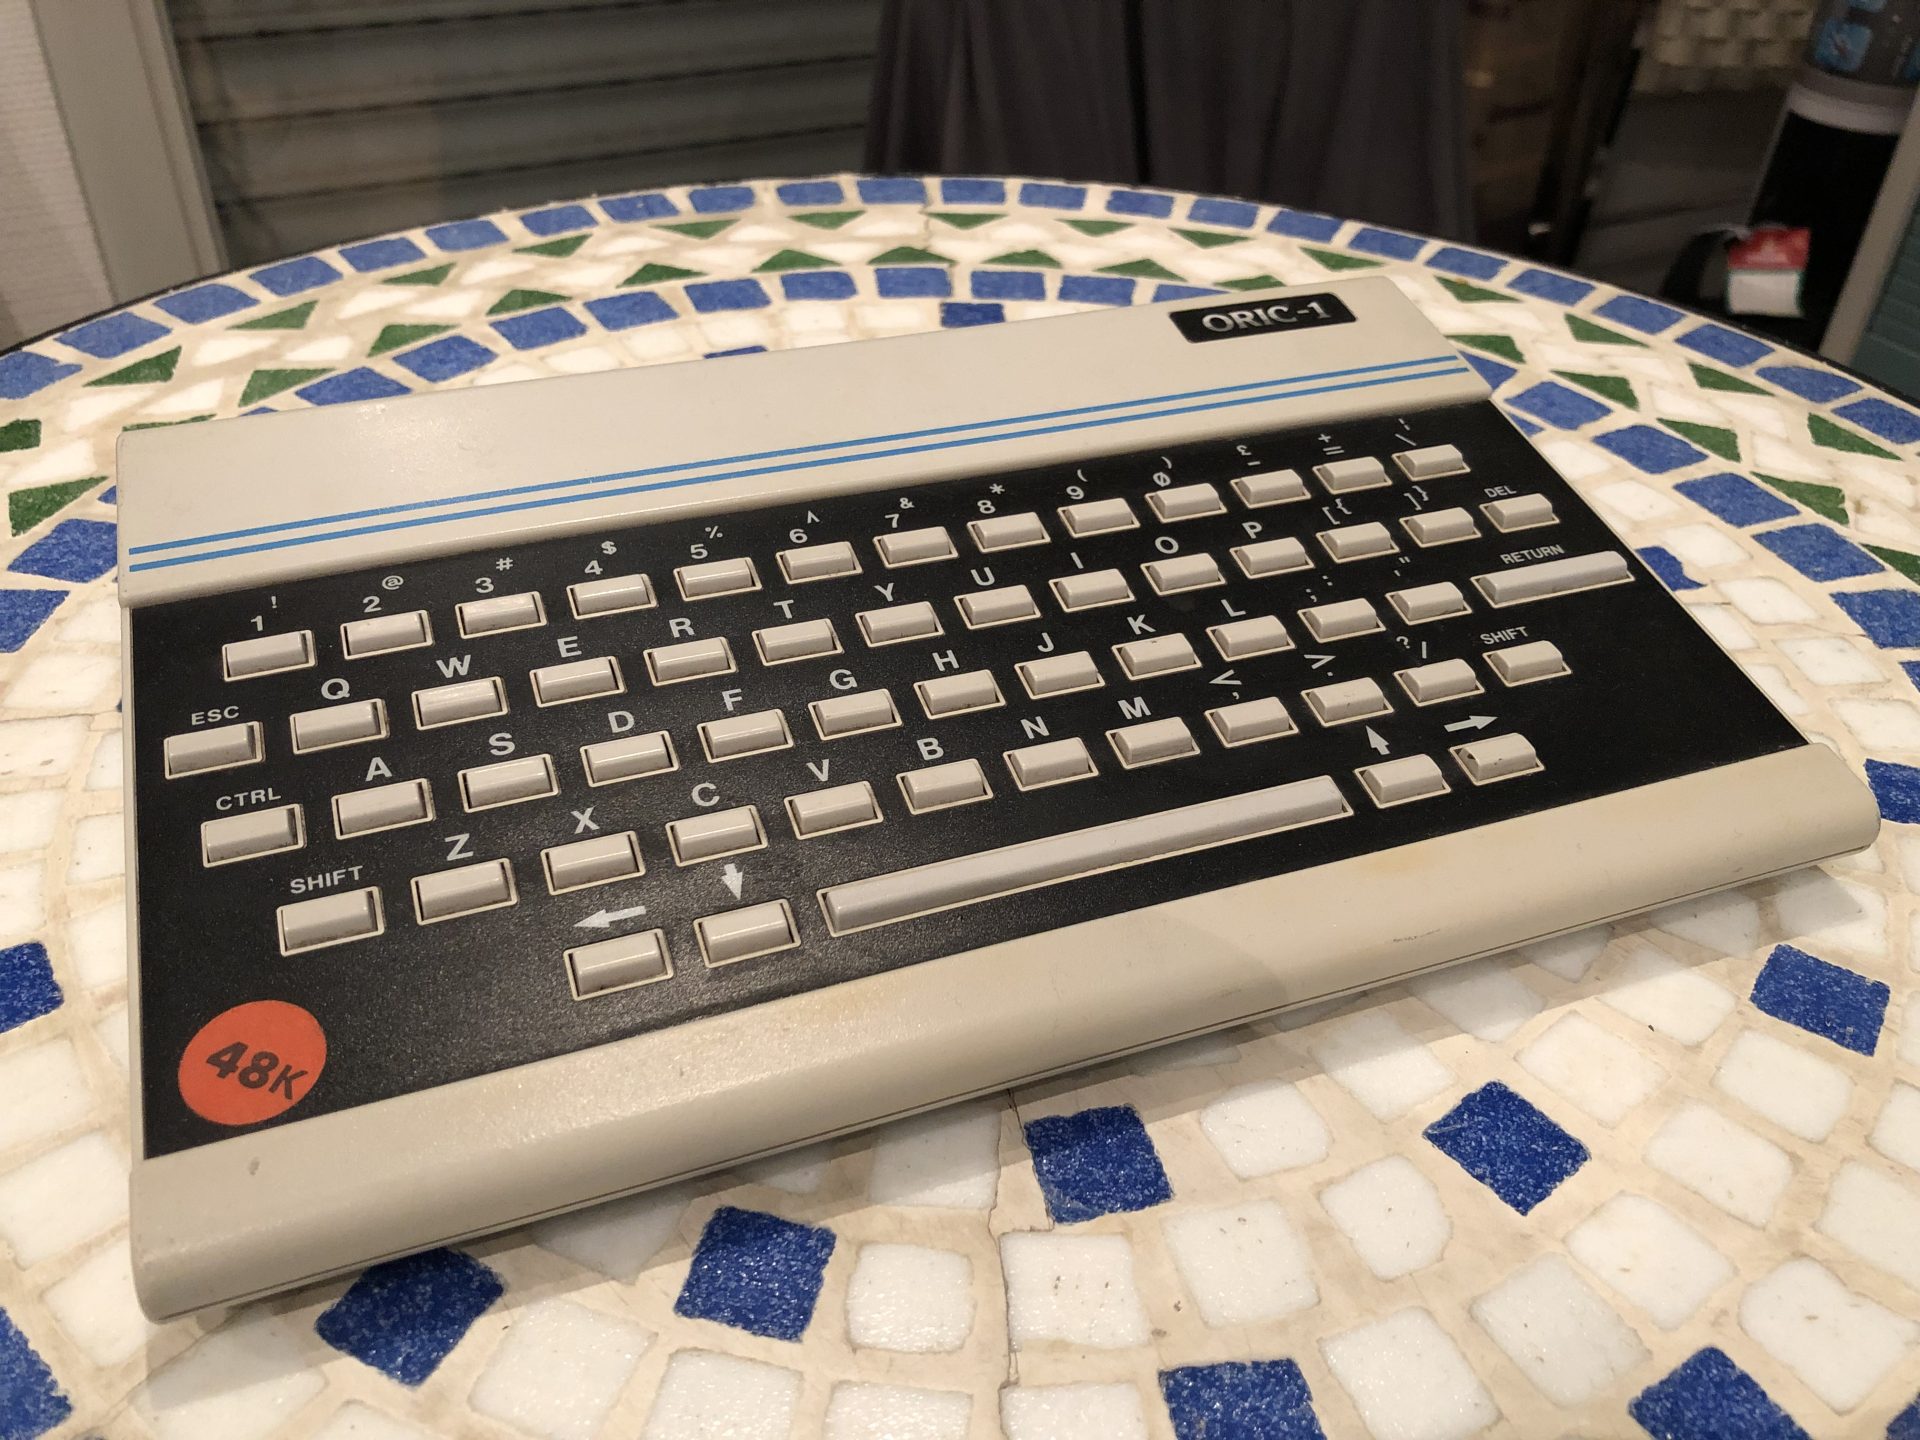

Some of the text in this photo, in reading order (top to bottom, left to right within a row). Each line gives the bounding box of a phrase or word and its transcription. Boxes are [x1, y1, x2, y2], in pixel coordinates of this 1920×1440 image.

[1201, 301, 1331, 332] ORIC-1
[1322, 445, 1345, 456] =
[1066, 485, 1085, 500] 9
[1484, 485, 1517, 499] DEL
[899, 497, 915, 509] &
[977, 499, 996, 514] 8
[884, 513, 900, 529] 7
[1241, 521, 1263, 539] P
[704, 525, 723, 539] %
[789, 528, 808, 544] 6
[601, 540, 617, 555] $
[690, 543, 708, 560] 5
[1154, 536, 1179, 555] O
[1500, 544, 1565, 566] RETURN
[495, 557, 514, 571] #
[585, 560, 603, 574] 4
[1070, 551, 1084, 570] I
[381, 575, 404, 591] @
[475, 577, 495, 594] 3
[970, 566, 995, 586] U
[873, 582, 895, 602] Y
[362, 595, 382, 613] 2
[773, 599, 794, 619] T
[1220, 599, 1247, 617] L
[250, 615, 264, 632] 1
[668, 617, 695, 638] R
[1126, 614, 1156, 635] K
[1037, 632, 1055, 653] J
[1396, 635, 1410, 649] ?
[1480, 626, 1530, 646] SHIFT
[556, 635, 582, 658] E
[435, 654, 472, 679] W
[932, 649, 960, 672] H
[1303, 654, 1336, 670] >
[829, 668, 858, 690] G
[1208, 669, 1242, 685] <
[320, 677, 351, 700] Q
[721, 688, 743, 712] F
[1117, 696, 1152, 720] M
[191, 706, 240, 725] ESC
[607, 710, 635, 734] D
[1020, 715, 1050, 740] N
[488, 732, 516, 756] S
[916, 737, 944, 761] B
[365, 756, 393, 782] A
[805, 758, 830, 782] V
[216, 787, 281, 811] CTRL
[690, 781, 720, 807] C
[570, 805, 601, 835] X
[444, 832, 474, 862] Z
[290, 866, 364, 894] SHIFT
[206, 1041, 308, 1100] 48K
